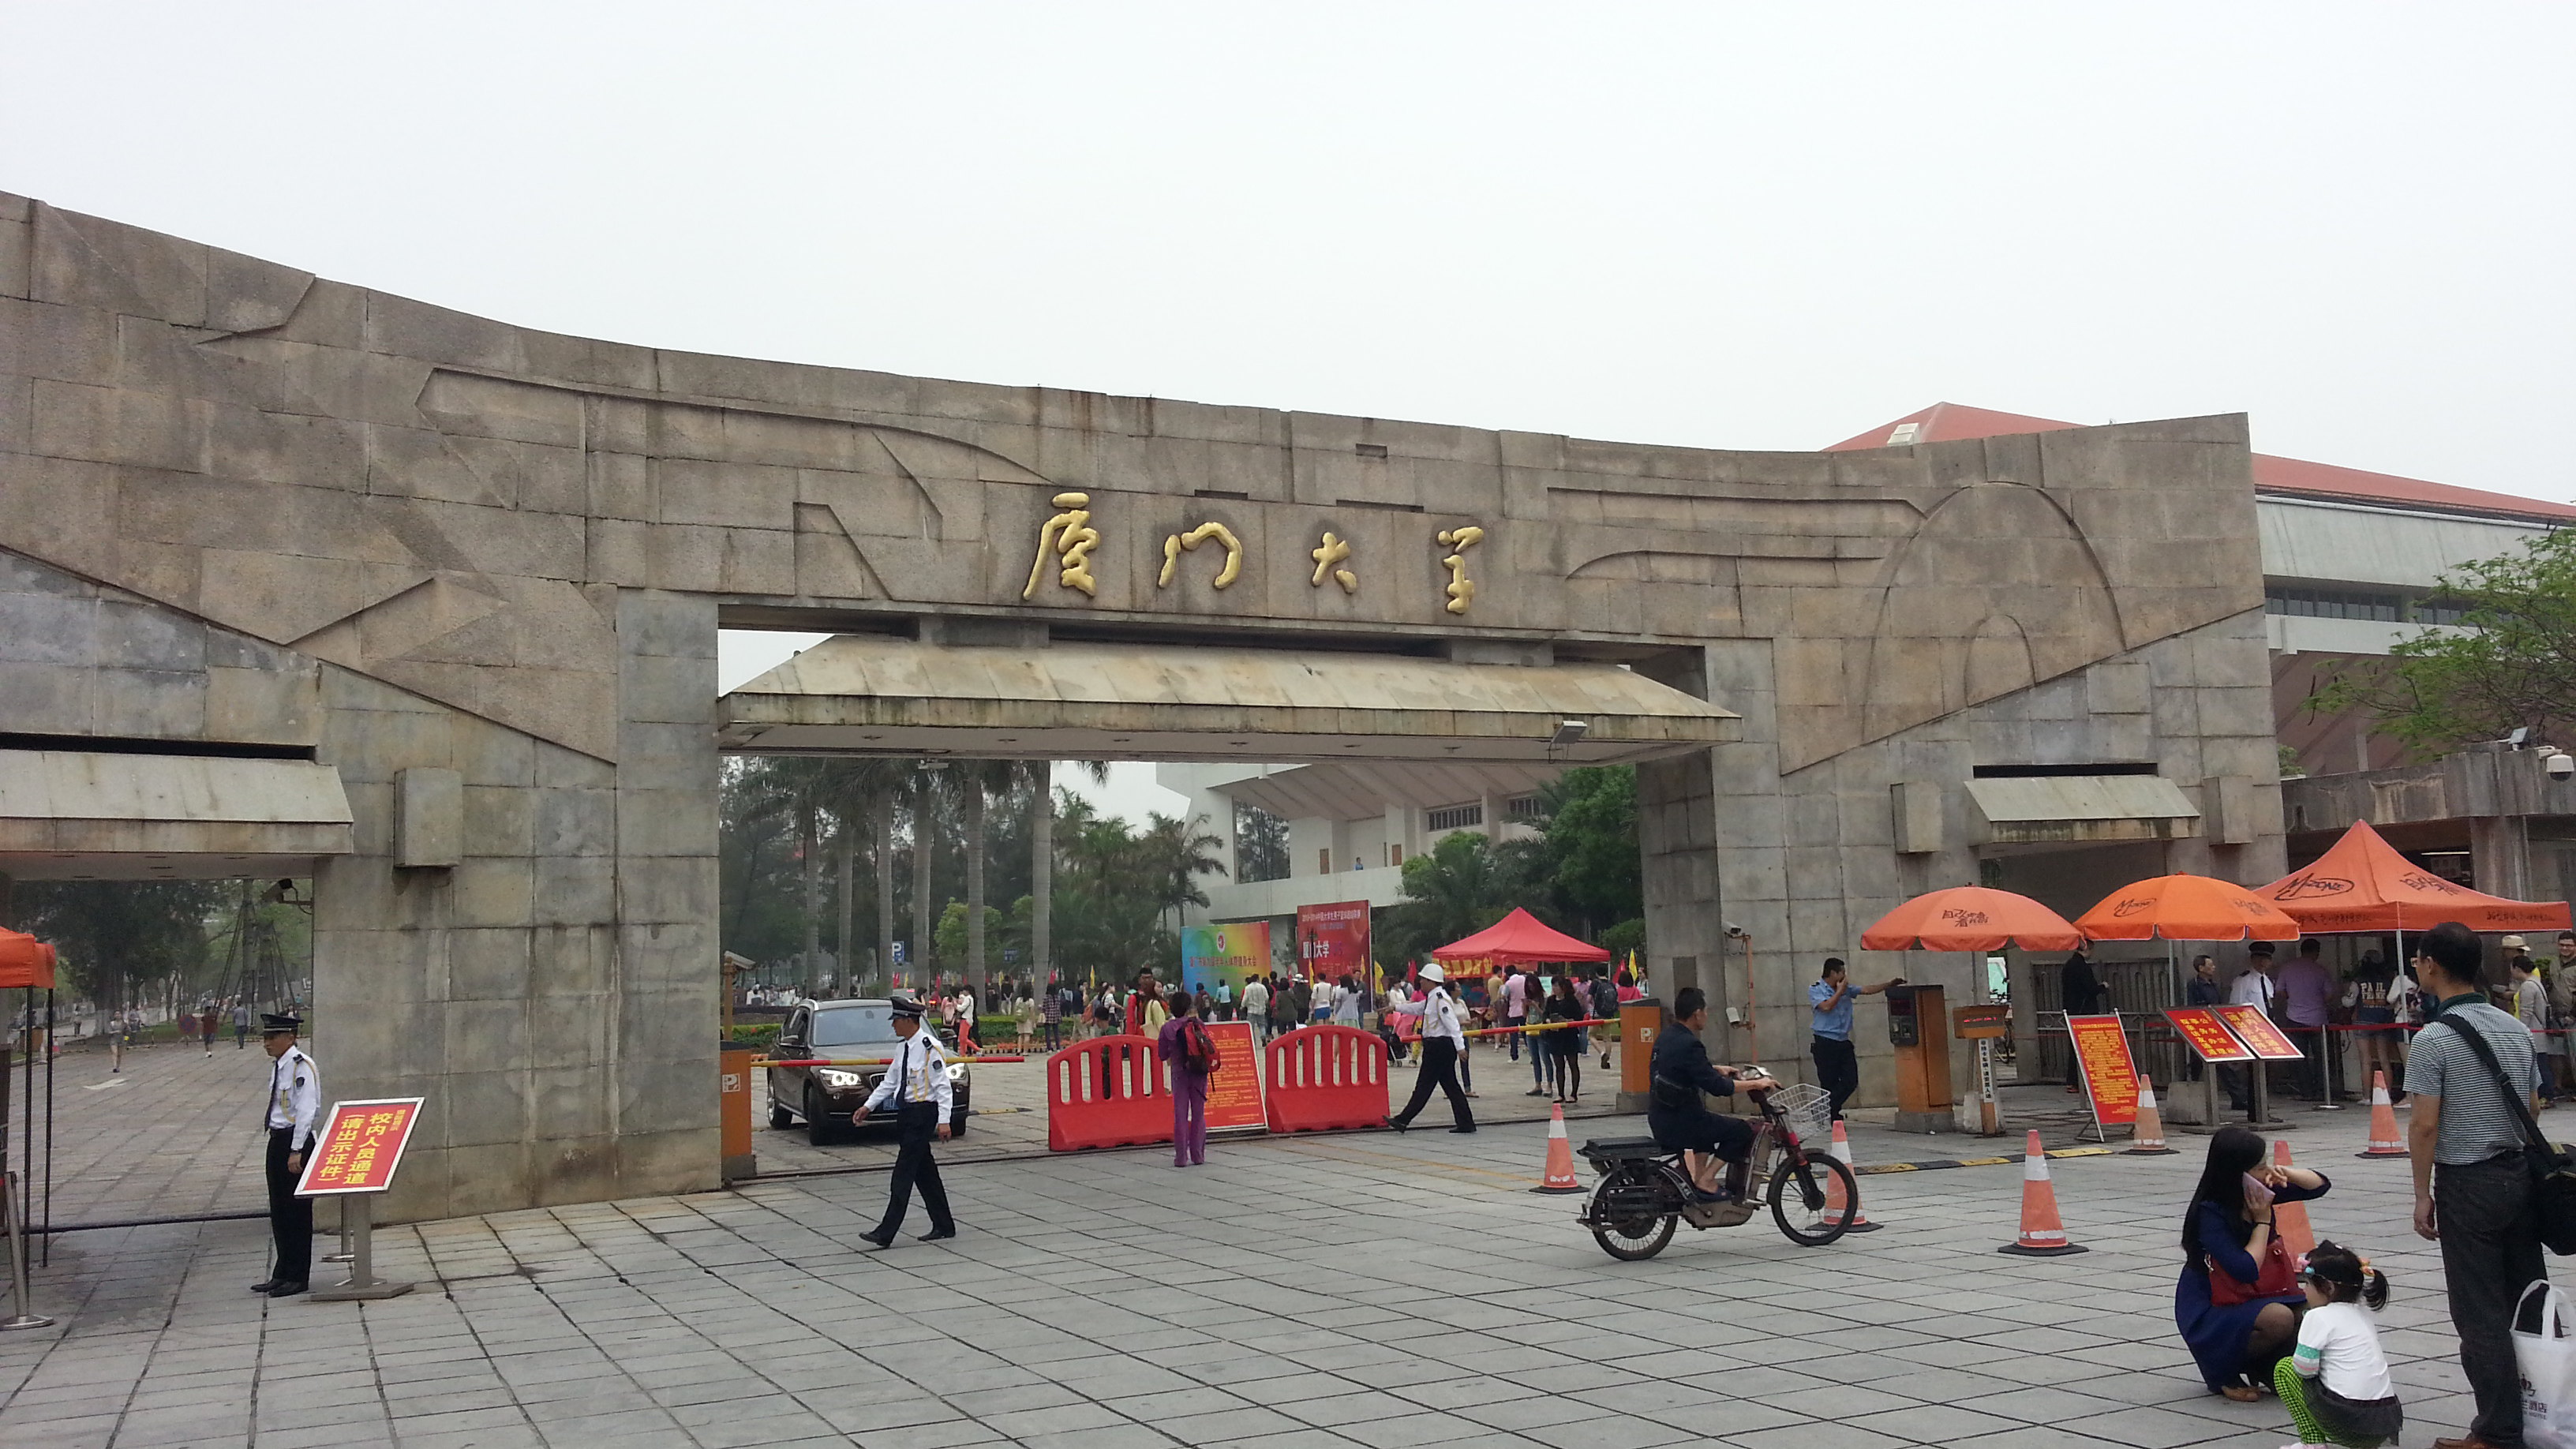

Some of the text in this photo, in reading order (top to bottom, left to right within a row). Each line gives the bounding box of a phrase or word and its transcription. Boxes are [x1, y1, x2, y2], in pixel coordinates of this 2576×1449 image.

[343, 1113, 393, 1185] 校内人员通道
